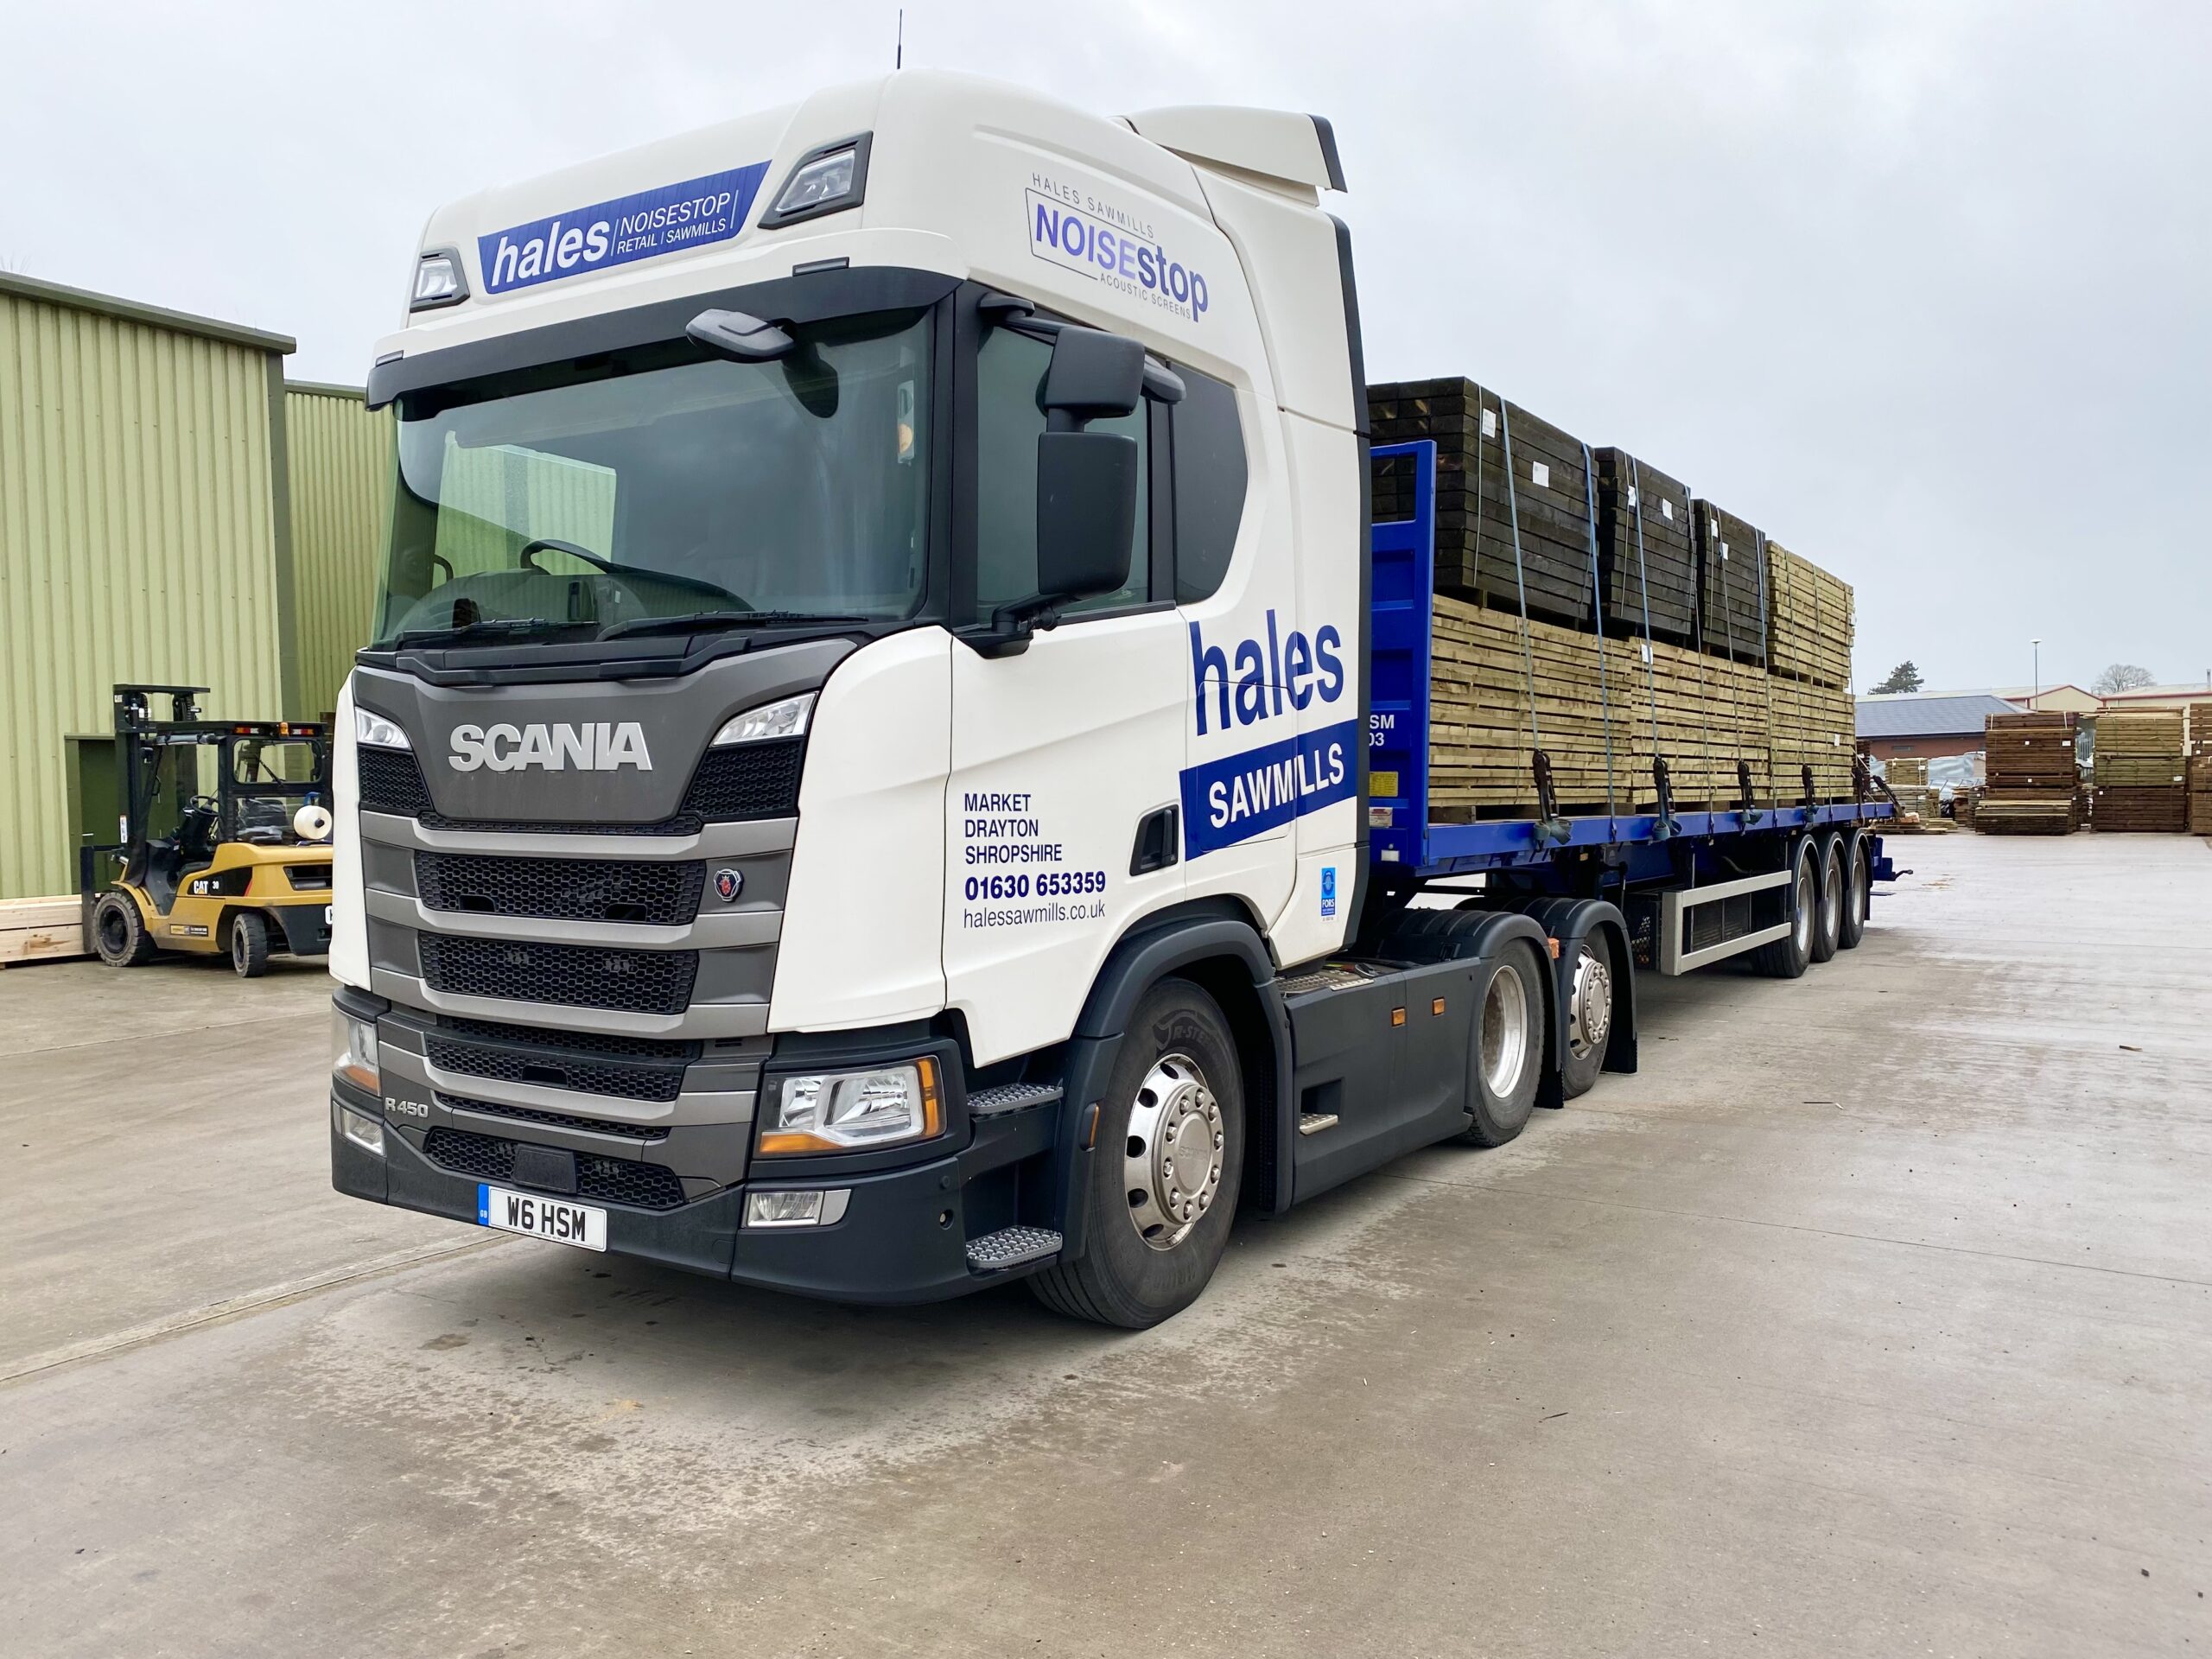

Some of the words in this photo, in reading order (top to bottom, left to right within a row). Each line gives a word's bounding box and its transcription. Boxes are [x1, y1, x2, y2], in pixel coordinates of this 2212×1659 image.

[620, 192, 730, 235] NOISESTOP
[1033, 173, 1080, 205] HALES
[1088, 197, 1154, 238] SAWMILLS
[492, 220, 610, 287] hales
[617, 232, 658, 254] RETAIL
[666, 218, 726, 244] SAWMILLS
[1036, 203, 1208, 322] NOISEstop
[1100, 273, 1147, 301] ACOUSTIC
[1151, 293, 1191, 320] SCREENS
[1189, 609, 1344, 736] hales
[448, 722, 653, 772] SCANIA
[964, 793, 1031, 811] MARKET
[1209, 742, 1344, 828] SAWMILLS
[965, 819, 1039, 837] DRAYTON
[965, 844, 1062, 864] SHROPSHIRE
[194, 880, 208, 894] CAT
[965, 874, 1029, 900] 01630
[1037, 871, 1106, 896] 653359
[1322, 899, 1334, 908] FORS
[963, 899, 1106, 928] halessawmills.co.uk
[385, 1097, 396, 1111] R
[397, 1100, 429, 1118] 450
[507, 1196, 534, 1230] W6
[541, 1203, 586, 1242] HSM
